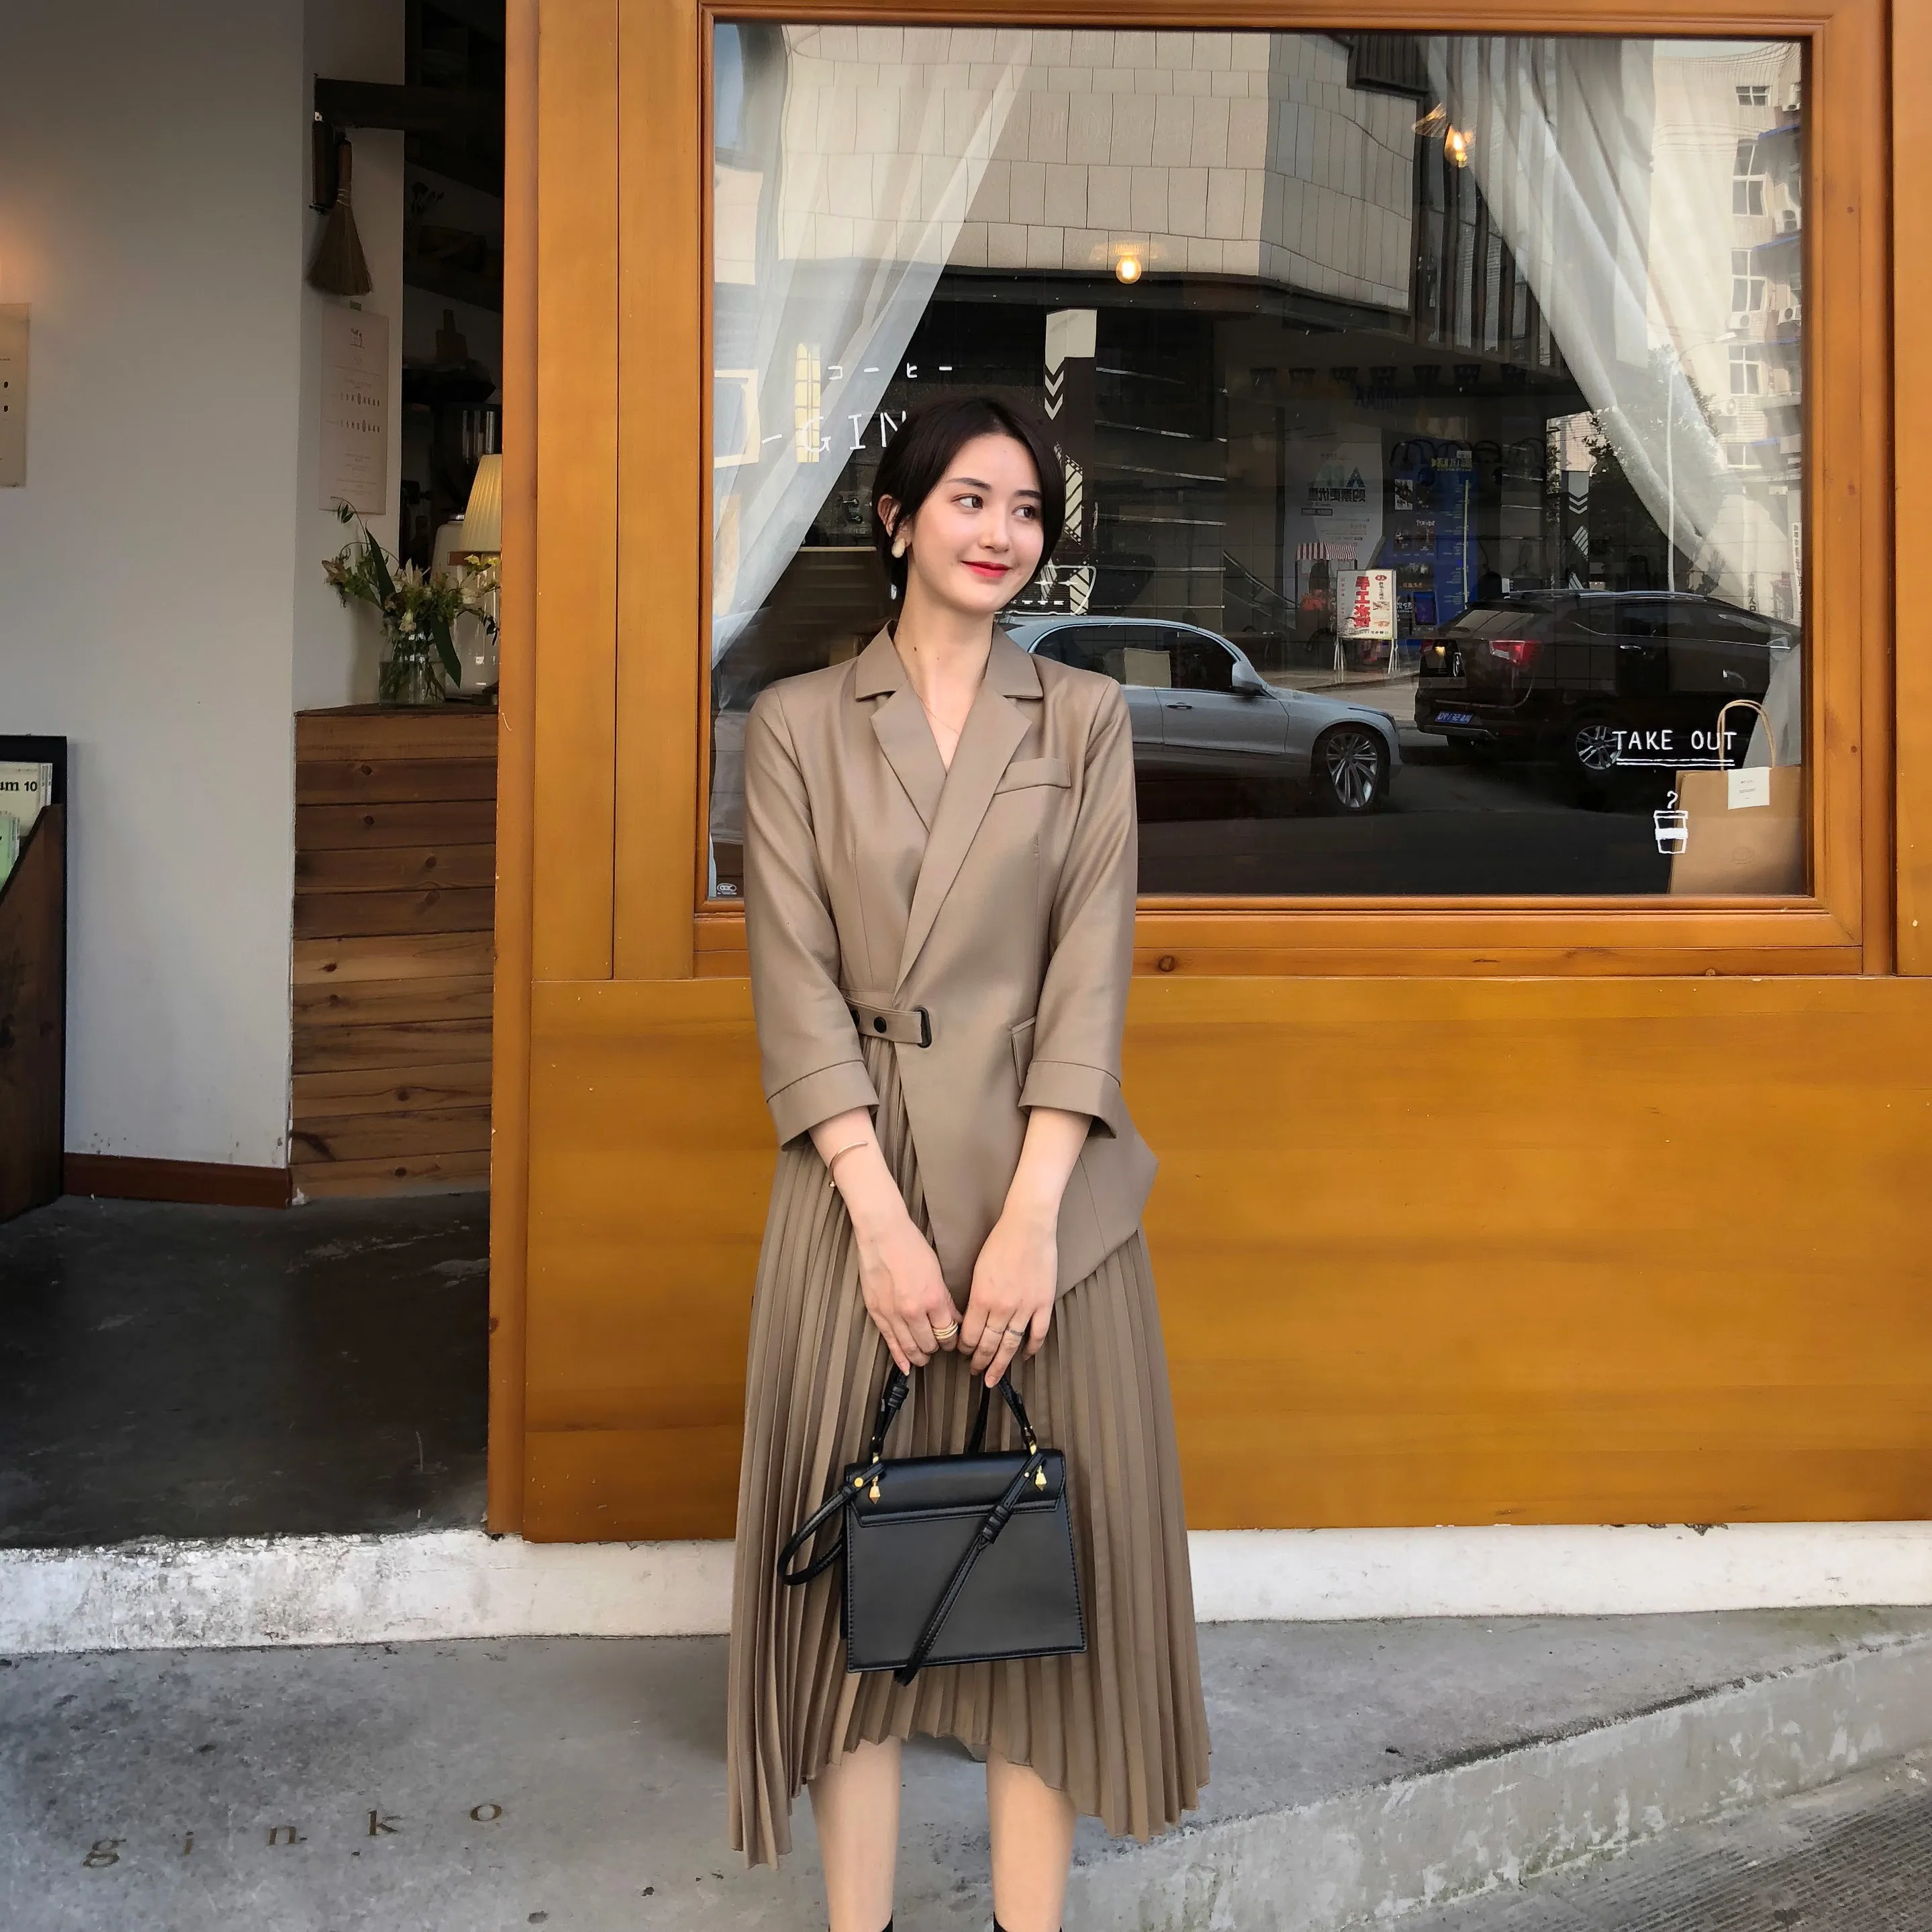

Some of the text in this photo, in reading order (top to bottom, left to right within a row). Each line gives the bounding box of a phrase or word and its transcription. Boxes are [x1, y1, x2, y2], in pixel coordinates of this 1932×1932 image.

[1612, 730, 1737, 750] TAKE OUT
[24, 781, 38, 791] 10
[82, 1804, 503, 1869] ginko
